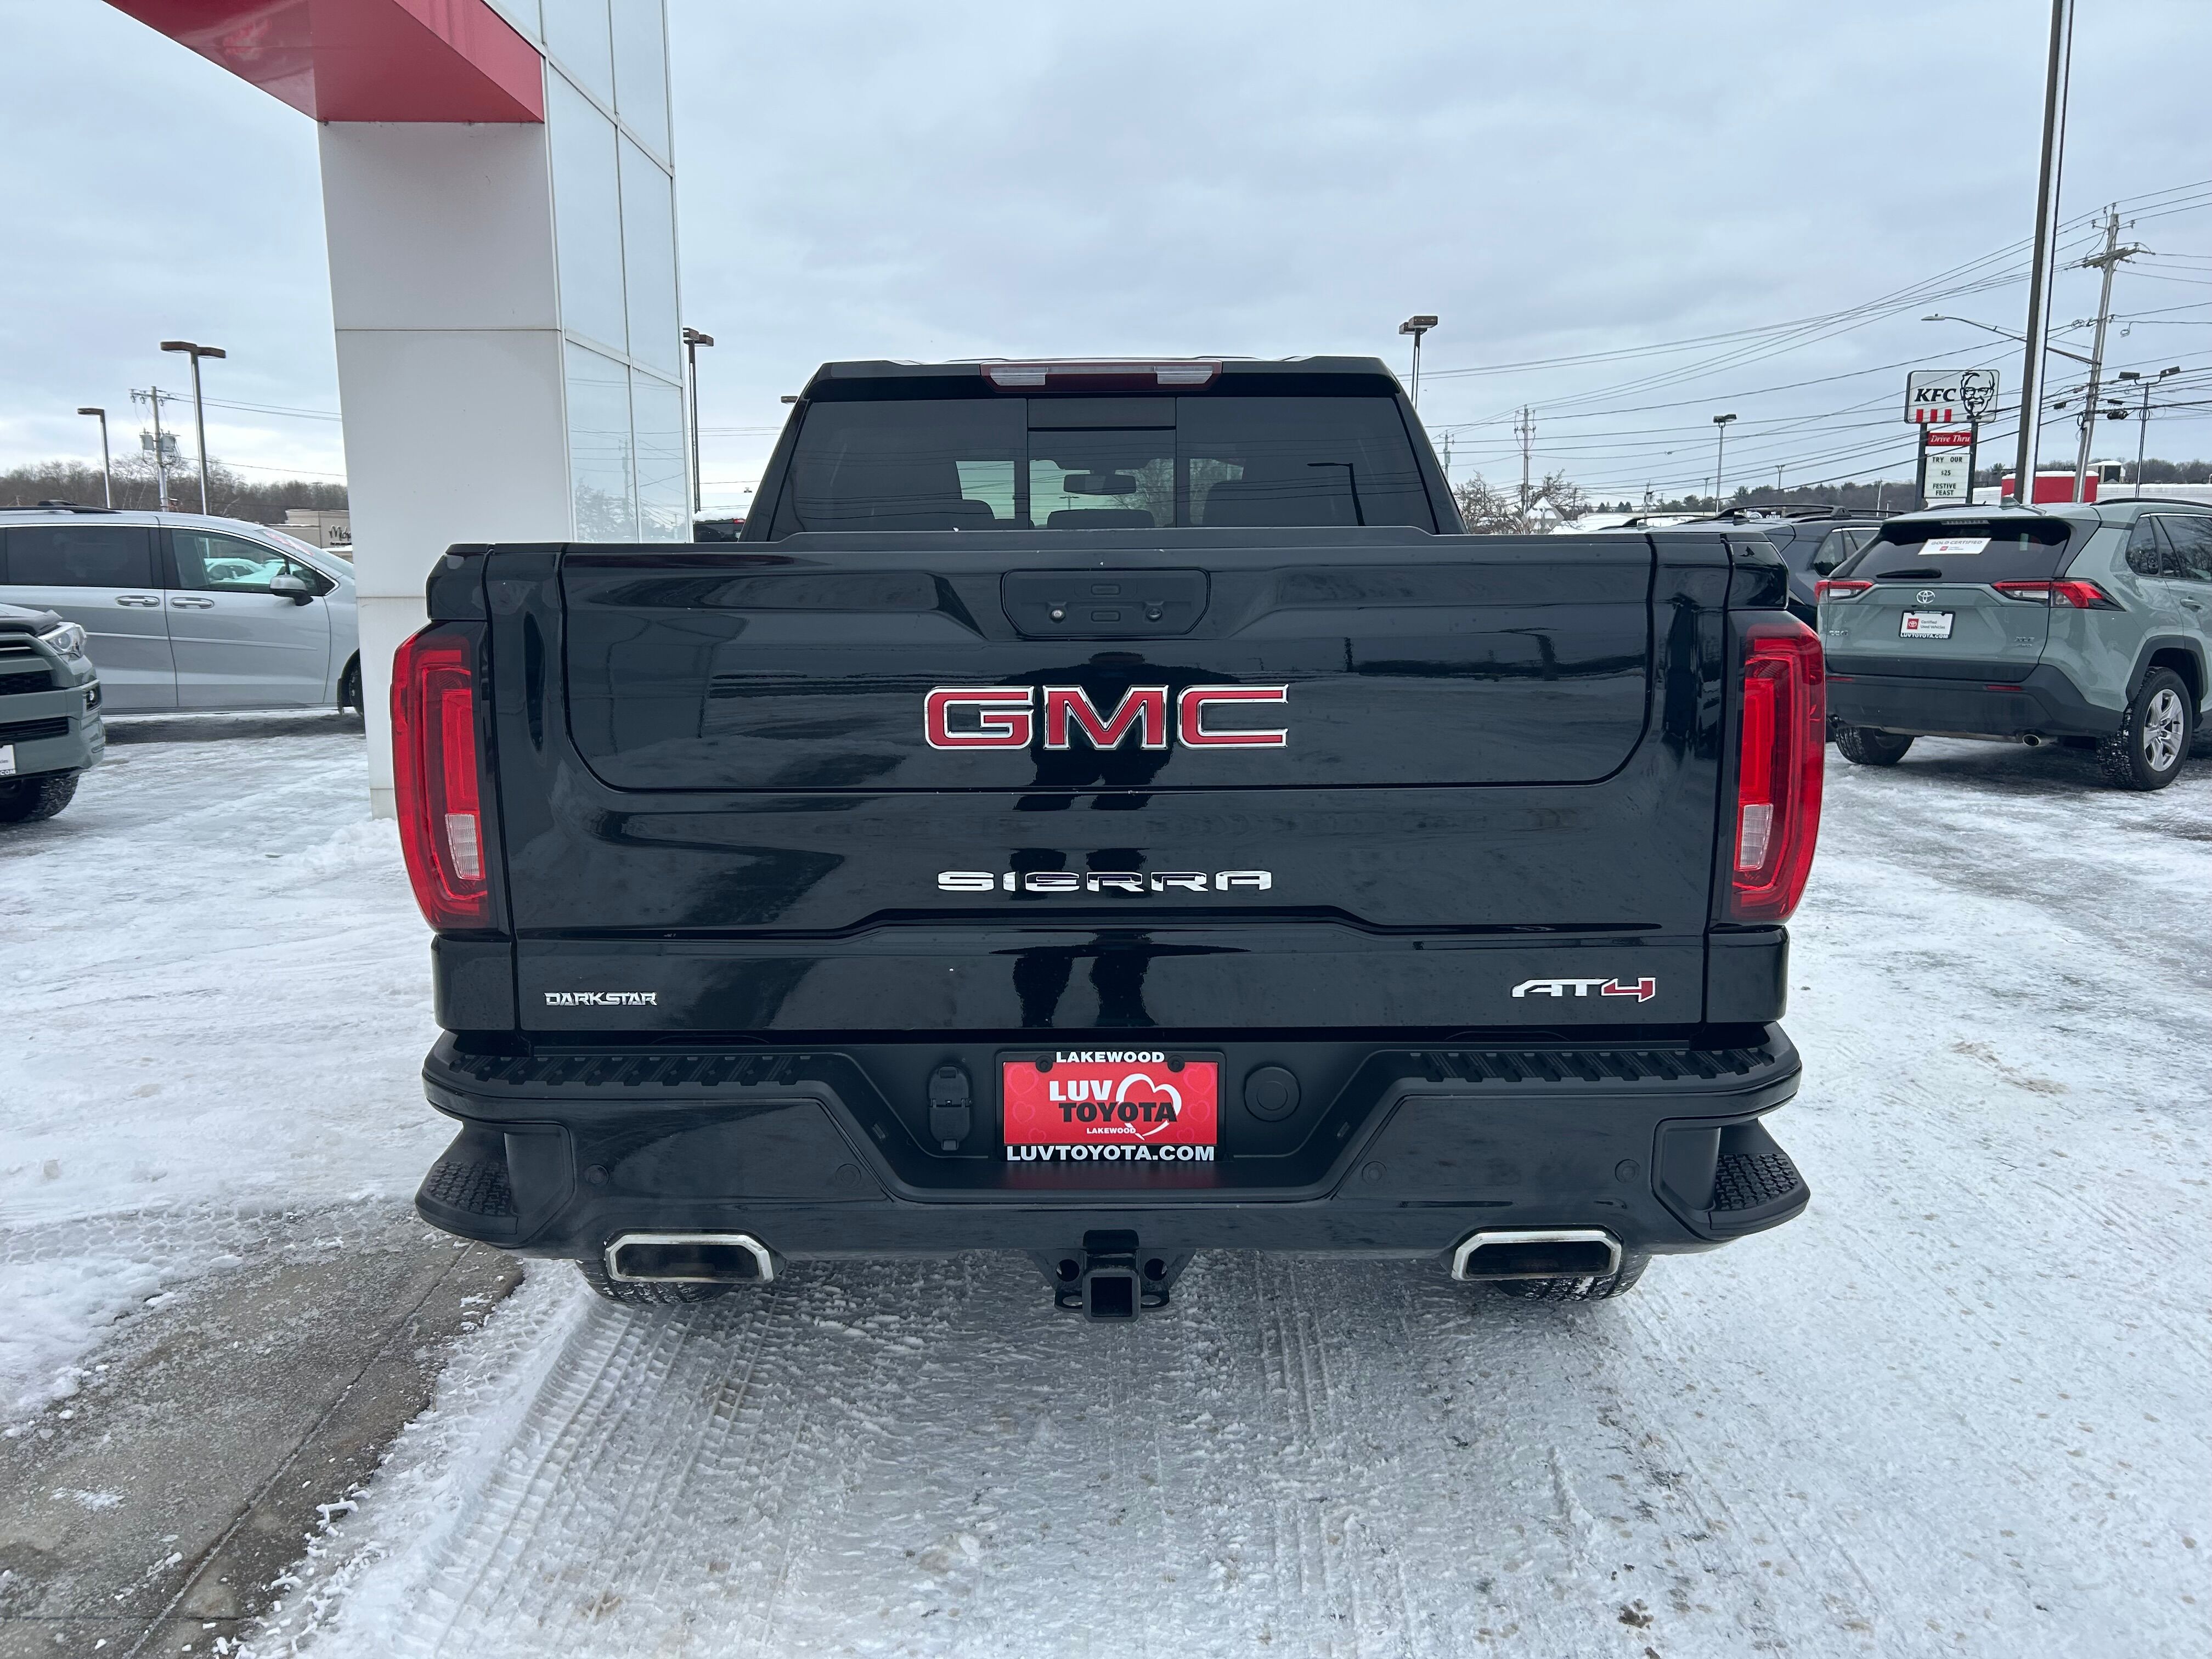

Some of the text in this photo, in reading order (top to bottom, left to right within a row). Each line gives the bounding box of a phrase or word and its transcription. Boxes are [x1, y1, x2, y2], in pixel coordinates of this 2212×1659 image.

[1915, 388, 1956, 402] KFC
[924, 684, 1289, 750] GMC
[938, 871, 1272, 892] SIERRA
[544, 992, 657, 1006] DARKSTAR
[1512, 977, 1656, 1003] AT4
[1056, 1051, 1165, 1063] LAKEWOOD
[1049, 1080, 1113, 1102] LUV
[1058, 1102, 1178, 1122] TOYOTA
[1007, 1145, 1215, 1161] LUVTOYOTA.COM
